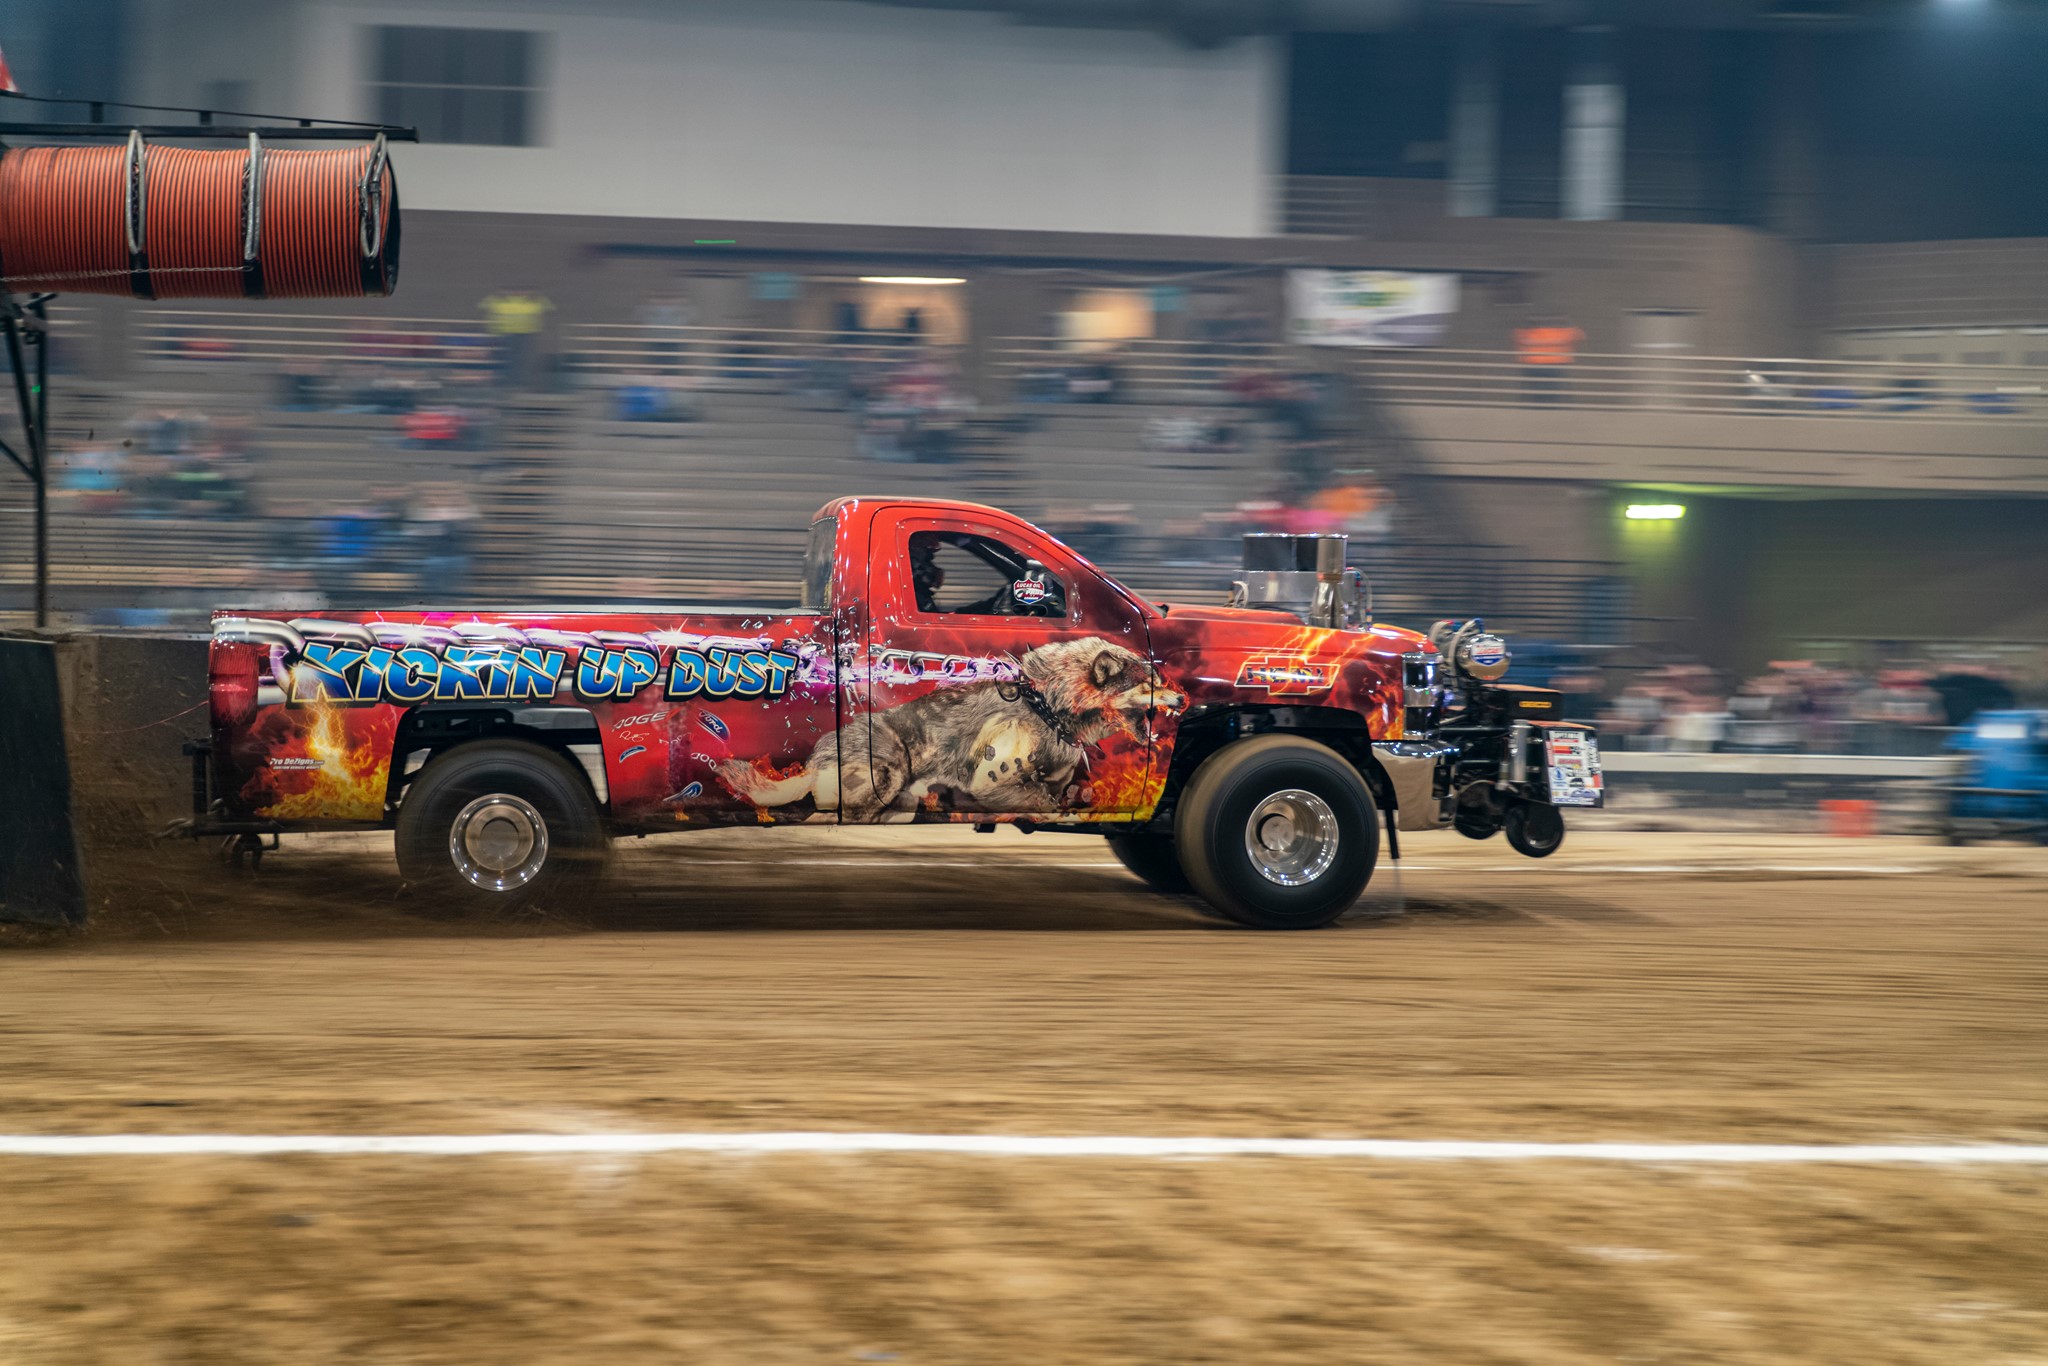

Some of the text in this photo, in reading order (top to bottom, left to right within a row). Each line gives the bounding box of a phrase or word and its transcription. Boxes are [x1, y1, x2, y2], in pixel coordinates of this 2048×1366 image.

[291, 641, 798, 703] KICKIN UP DUST
[1246, 666, 1325, 683] HEMI
[700, 710, 724, 734] Ford
